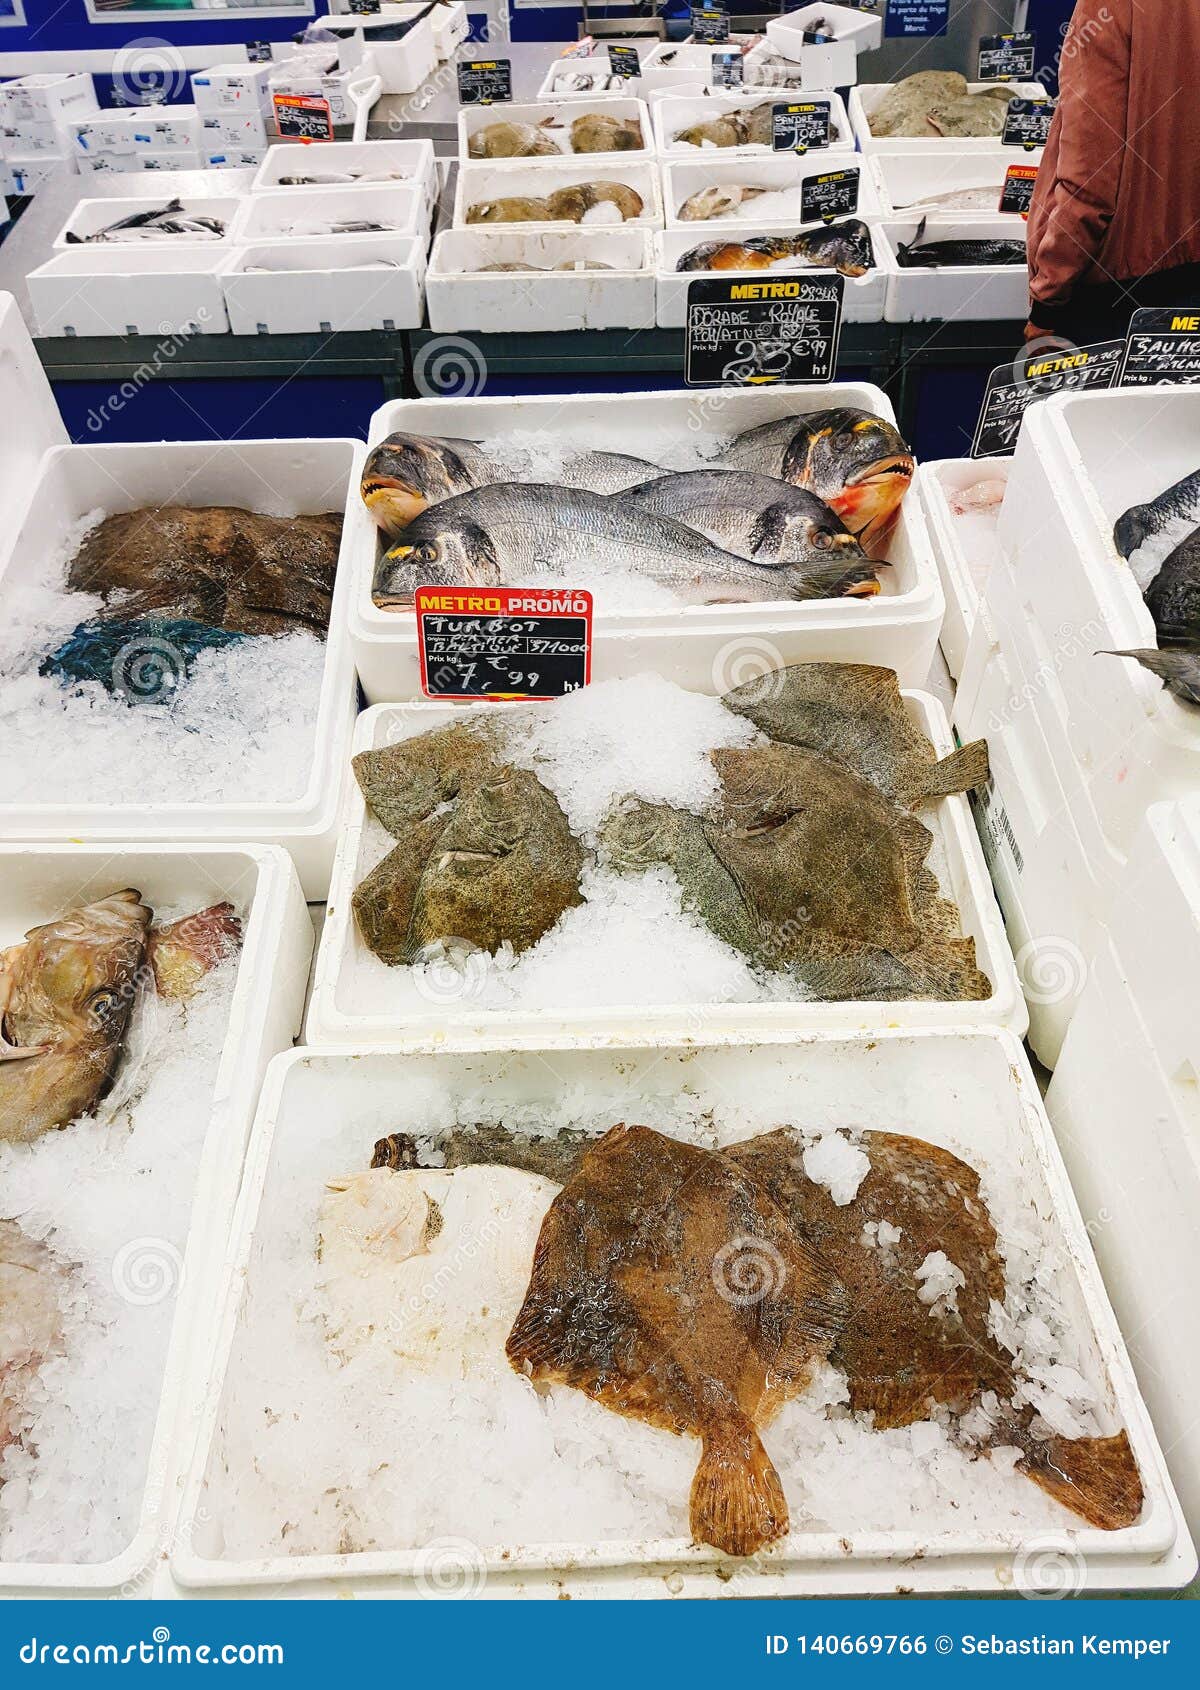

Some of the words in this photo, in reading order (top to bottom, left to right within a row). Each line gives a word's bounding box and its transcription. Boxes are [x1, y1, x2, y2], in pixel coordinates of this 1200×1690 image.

[787, 104, 816, 113] METRO
[817, 172, 845, 184] METRO
[1007, 168, 1038, 178] METRO
[730, 282, 800, 299] METRO
[812, 364, 828, 375] ht
[1027, 353, 1089, 378] METRO
[1051, 363, 1117, 390] LOTTE
[420, 595, 501, 612] METRO
[508, 598, 588, 614] PROMO
[429, 655, 445, 663] Prix
[446, 655, 456, 664] kg
[564, 681, 581, 692] ht
